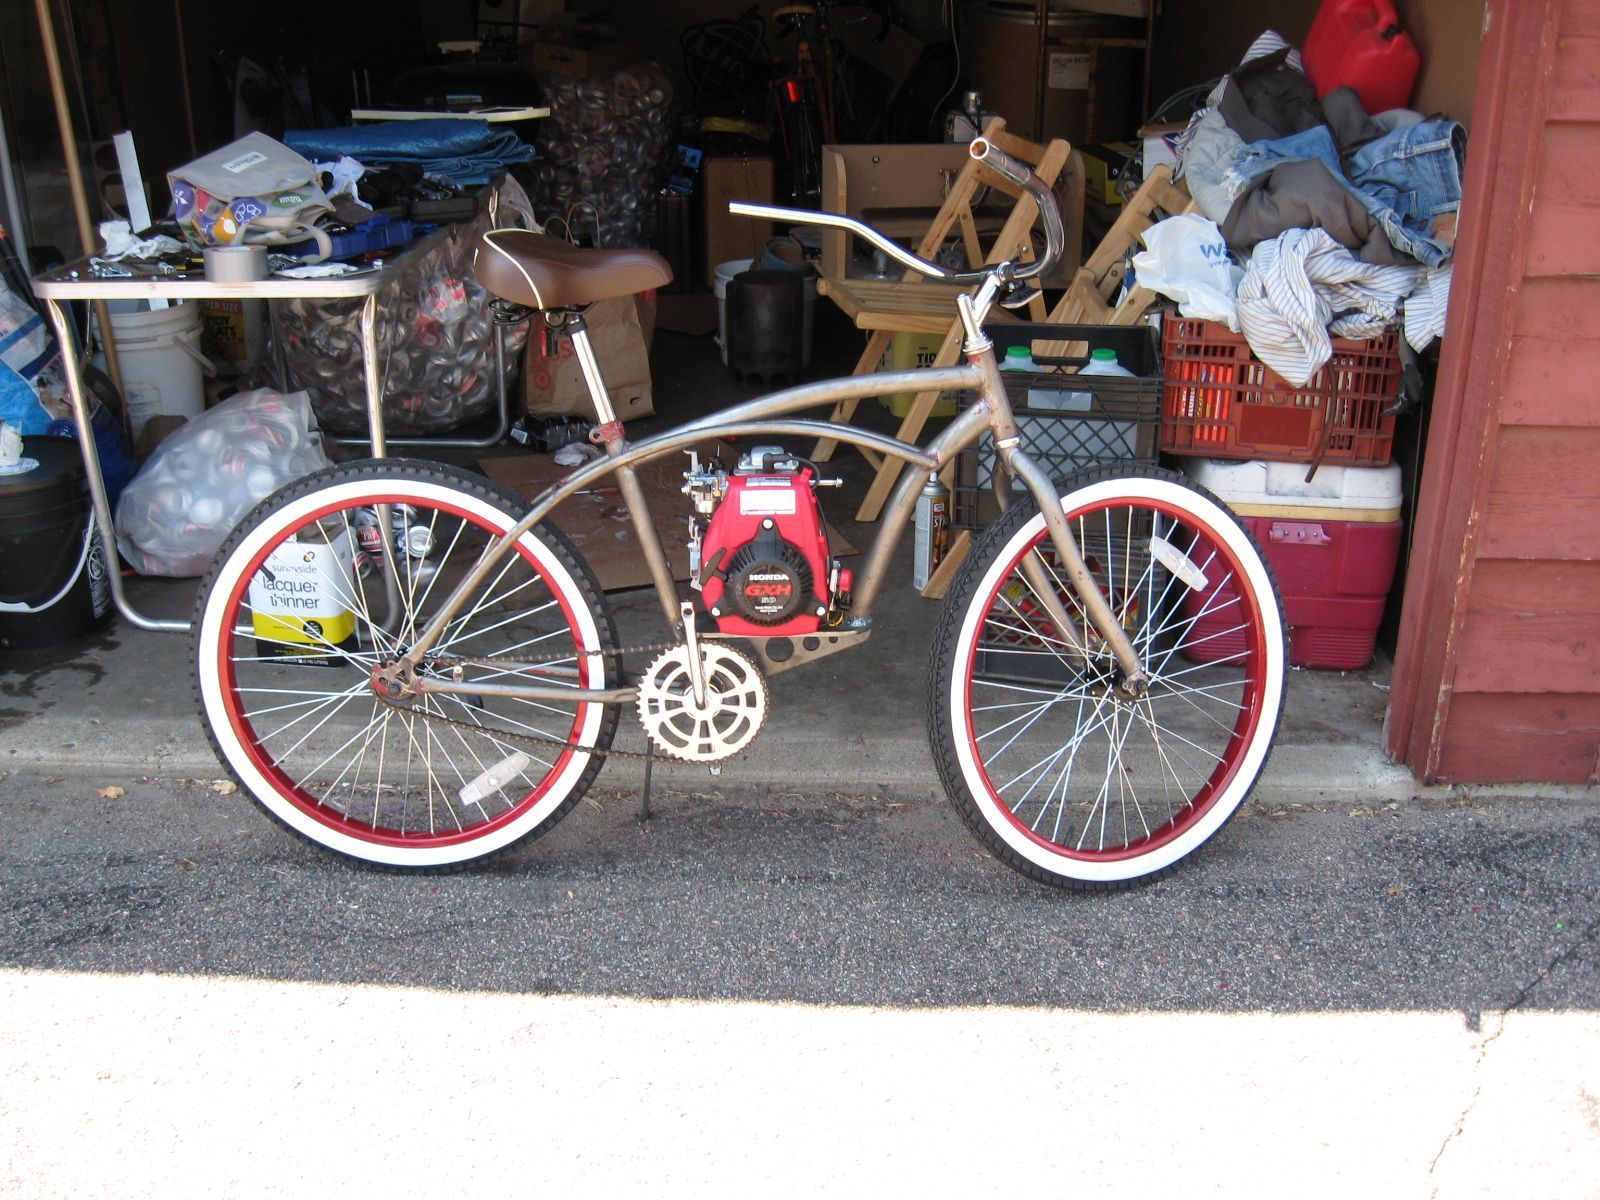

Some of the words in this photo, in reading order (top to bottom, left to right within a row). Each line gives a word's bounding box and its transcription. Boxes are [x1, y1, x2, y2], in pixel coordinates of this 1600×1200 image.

[916, 352, 939, 364] TID
[263, 577, 318, 593] lacquer
[745, 584, 792, 596] GXH
[271, 593, 320, 609] thinner
